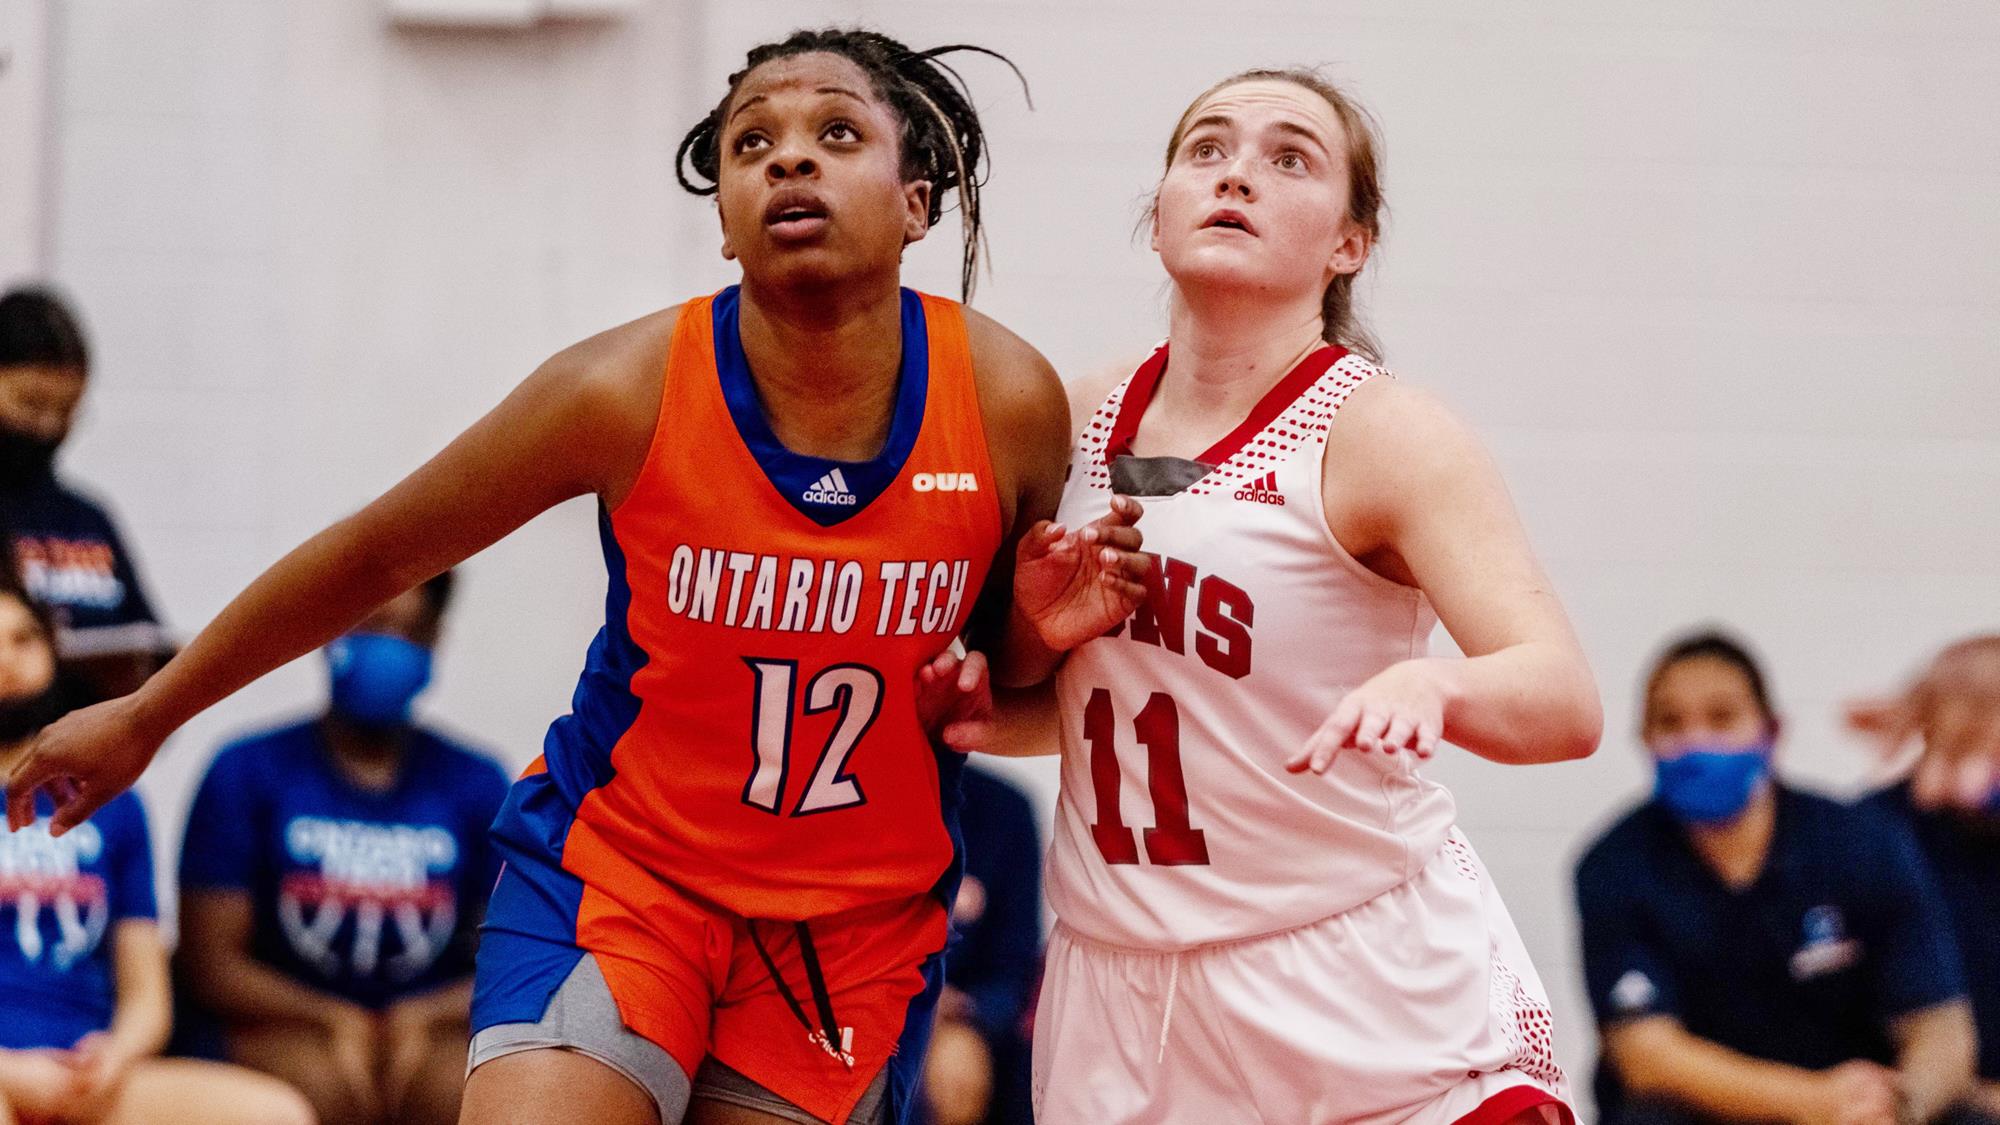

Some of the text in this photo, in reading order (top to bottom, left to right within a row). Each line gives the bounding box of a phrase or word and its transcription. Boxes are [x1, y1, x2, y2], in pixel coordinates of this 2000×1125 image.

[802, 488, 857, 506] adidas
[912, 472, 979, 492] OUA
[1234, 489, 1286, 506] adidas
[666, 543, 971, 637] ONTARIO TECH
[1100, 550, 1255, 681] NS
[740, 656, 887, 818] 12
[1083, 687, 1210, 866] 11
